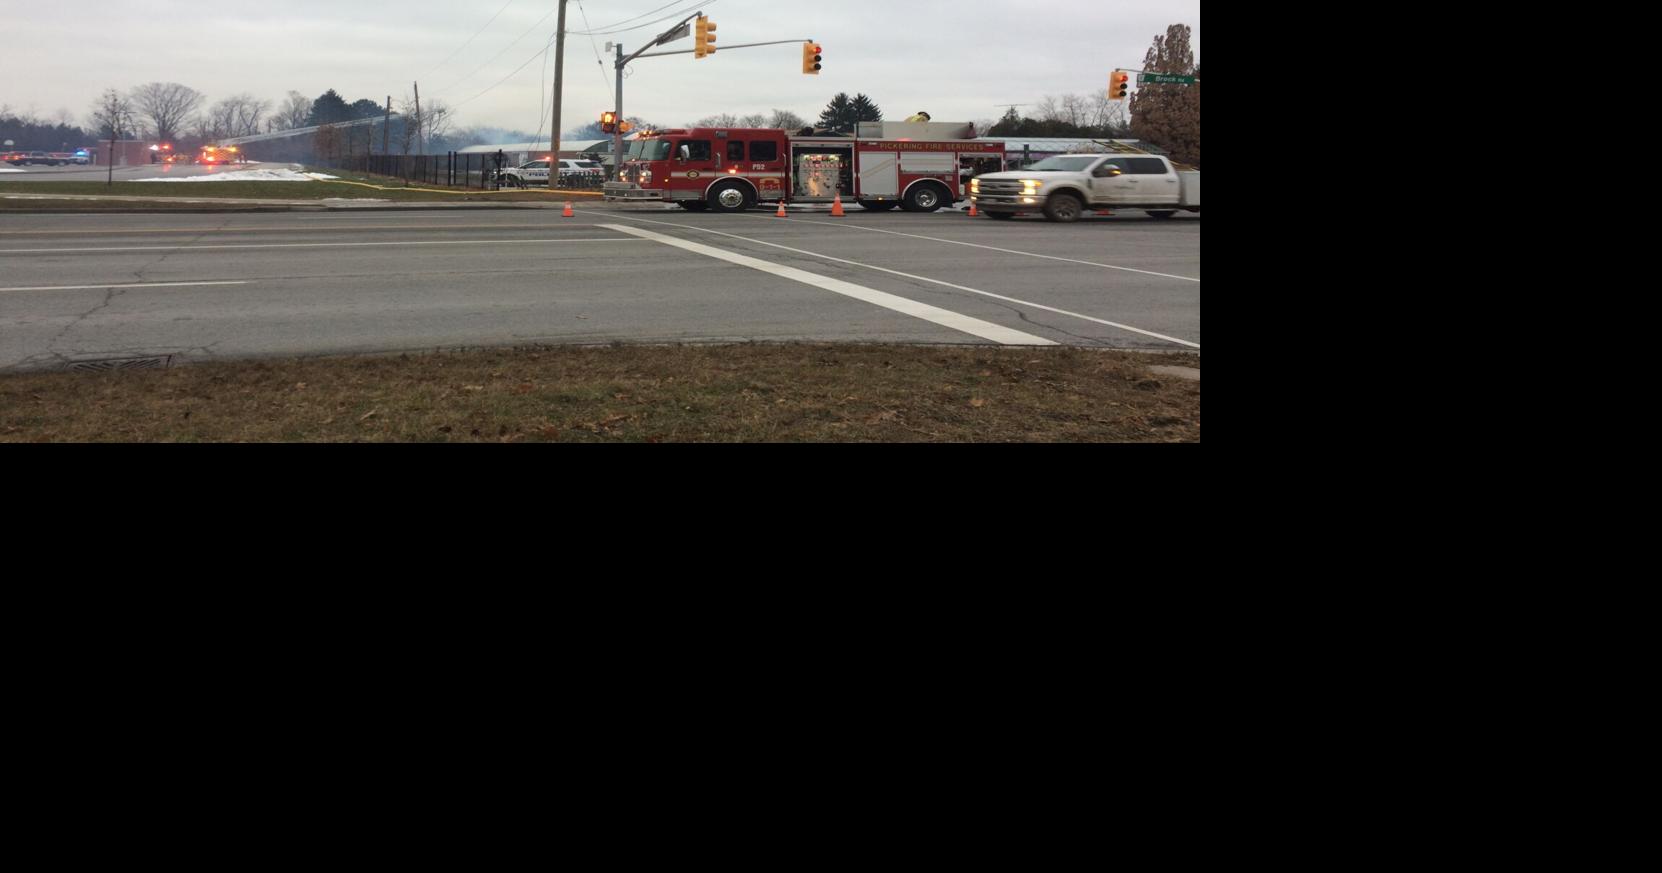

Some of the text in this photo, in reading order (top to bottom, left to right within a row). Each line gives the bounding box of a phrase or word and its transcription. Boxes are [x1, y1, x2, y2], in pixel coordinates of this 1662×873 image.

[880, 142, 984, 151] PICKERING FIRE SERVICES
